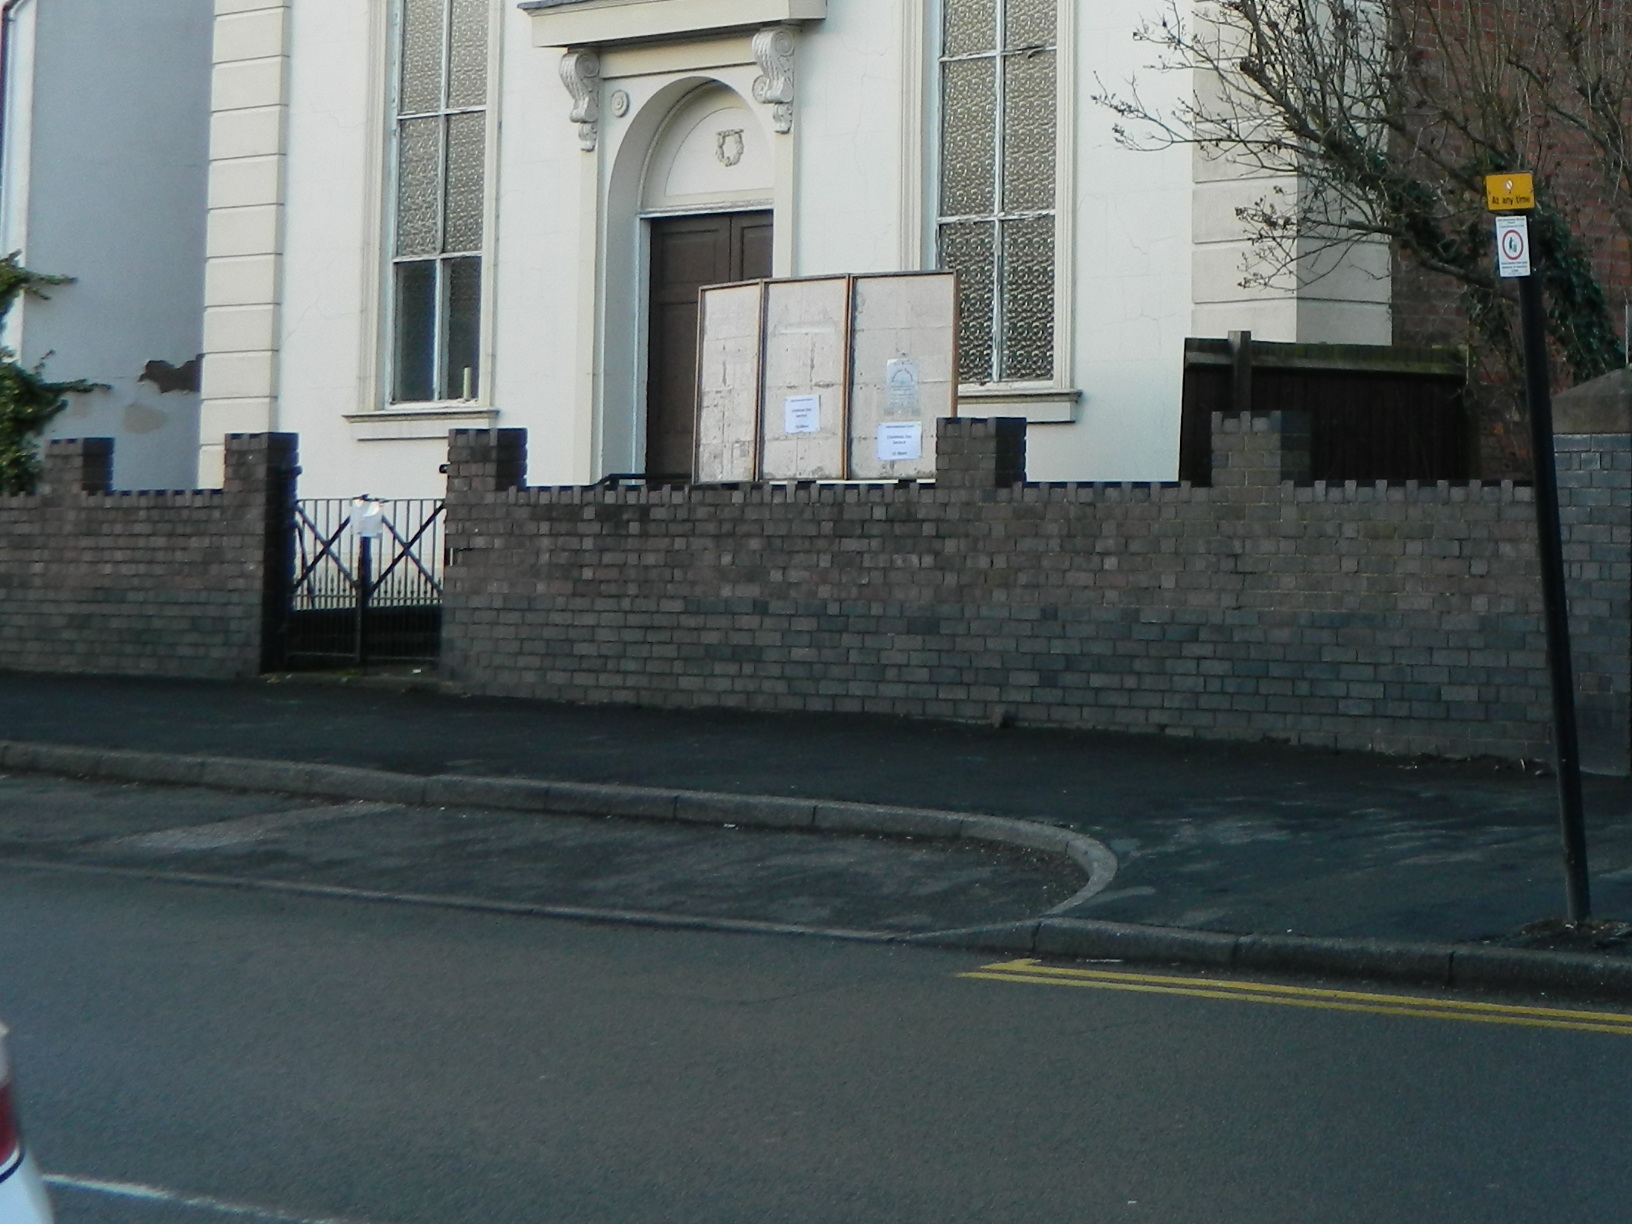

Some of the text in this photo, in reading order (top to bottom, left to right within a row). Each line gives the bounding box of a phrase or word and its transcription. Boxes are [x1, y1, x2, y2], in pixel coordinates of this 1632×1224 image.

[1492, 194, 1531, 206] At any time
